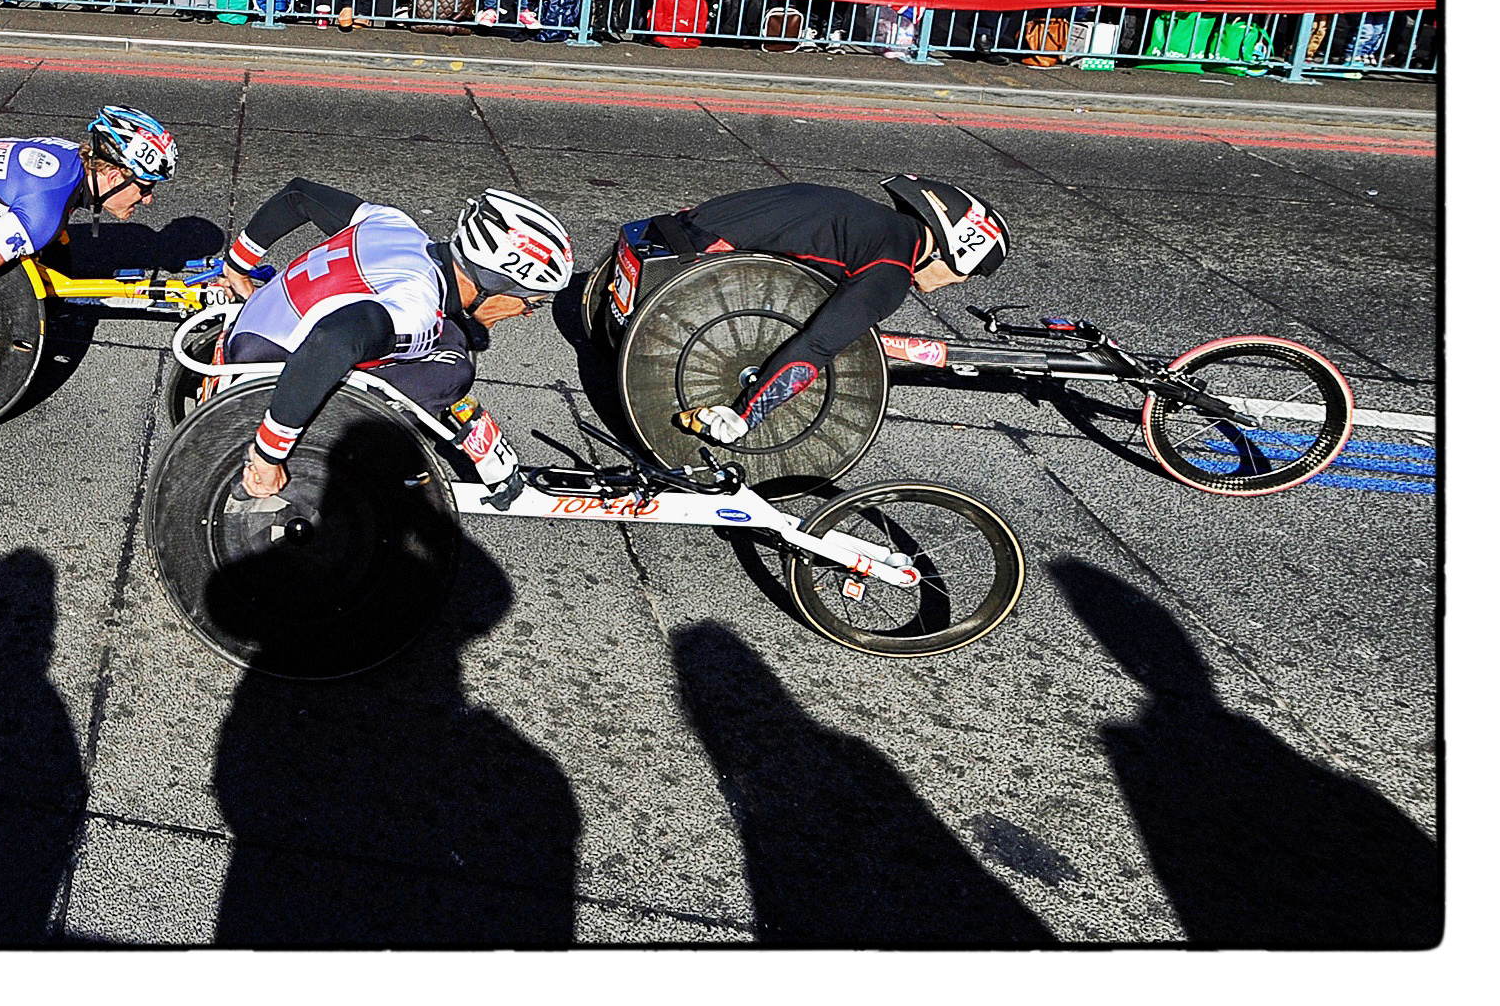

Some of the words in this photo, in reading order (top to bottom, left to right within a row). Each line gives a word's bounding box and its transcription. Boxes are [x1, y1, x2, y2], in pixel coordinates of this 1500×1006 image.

[135, 142, 158, 164] 36
[958, 227, 986, 252] 32
[499, 252, 534, 280] 24
[551, 496, 603, 514] TOP
